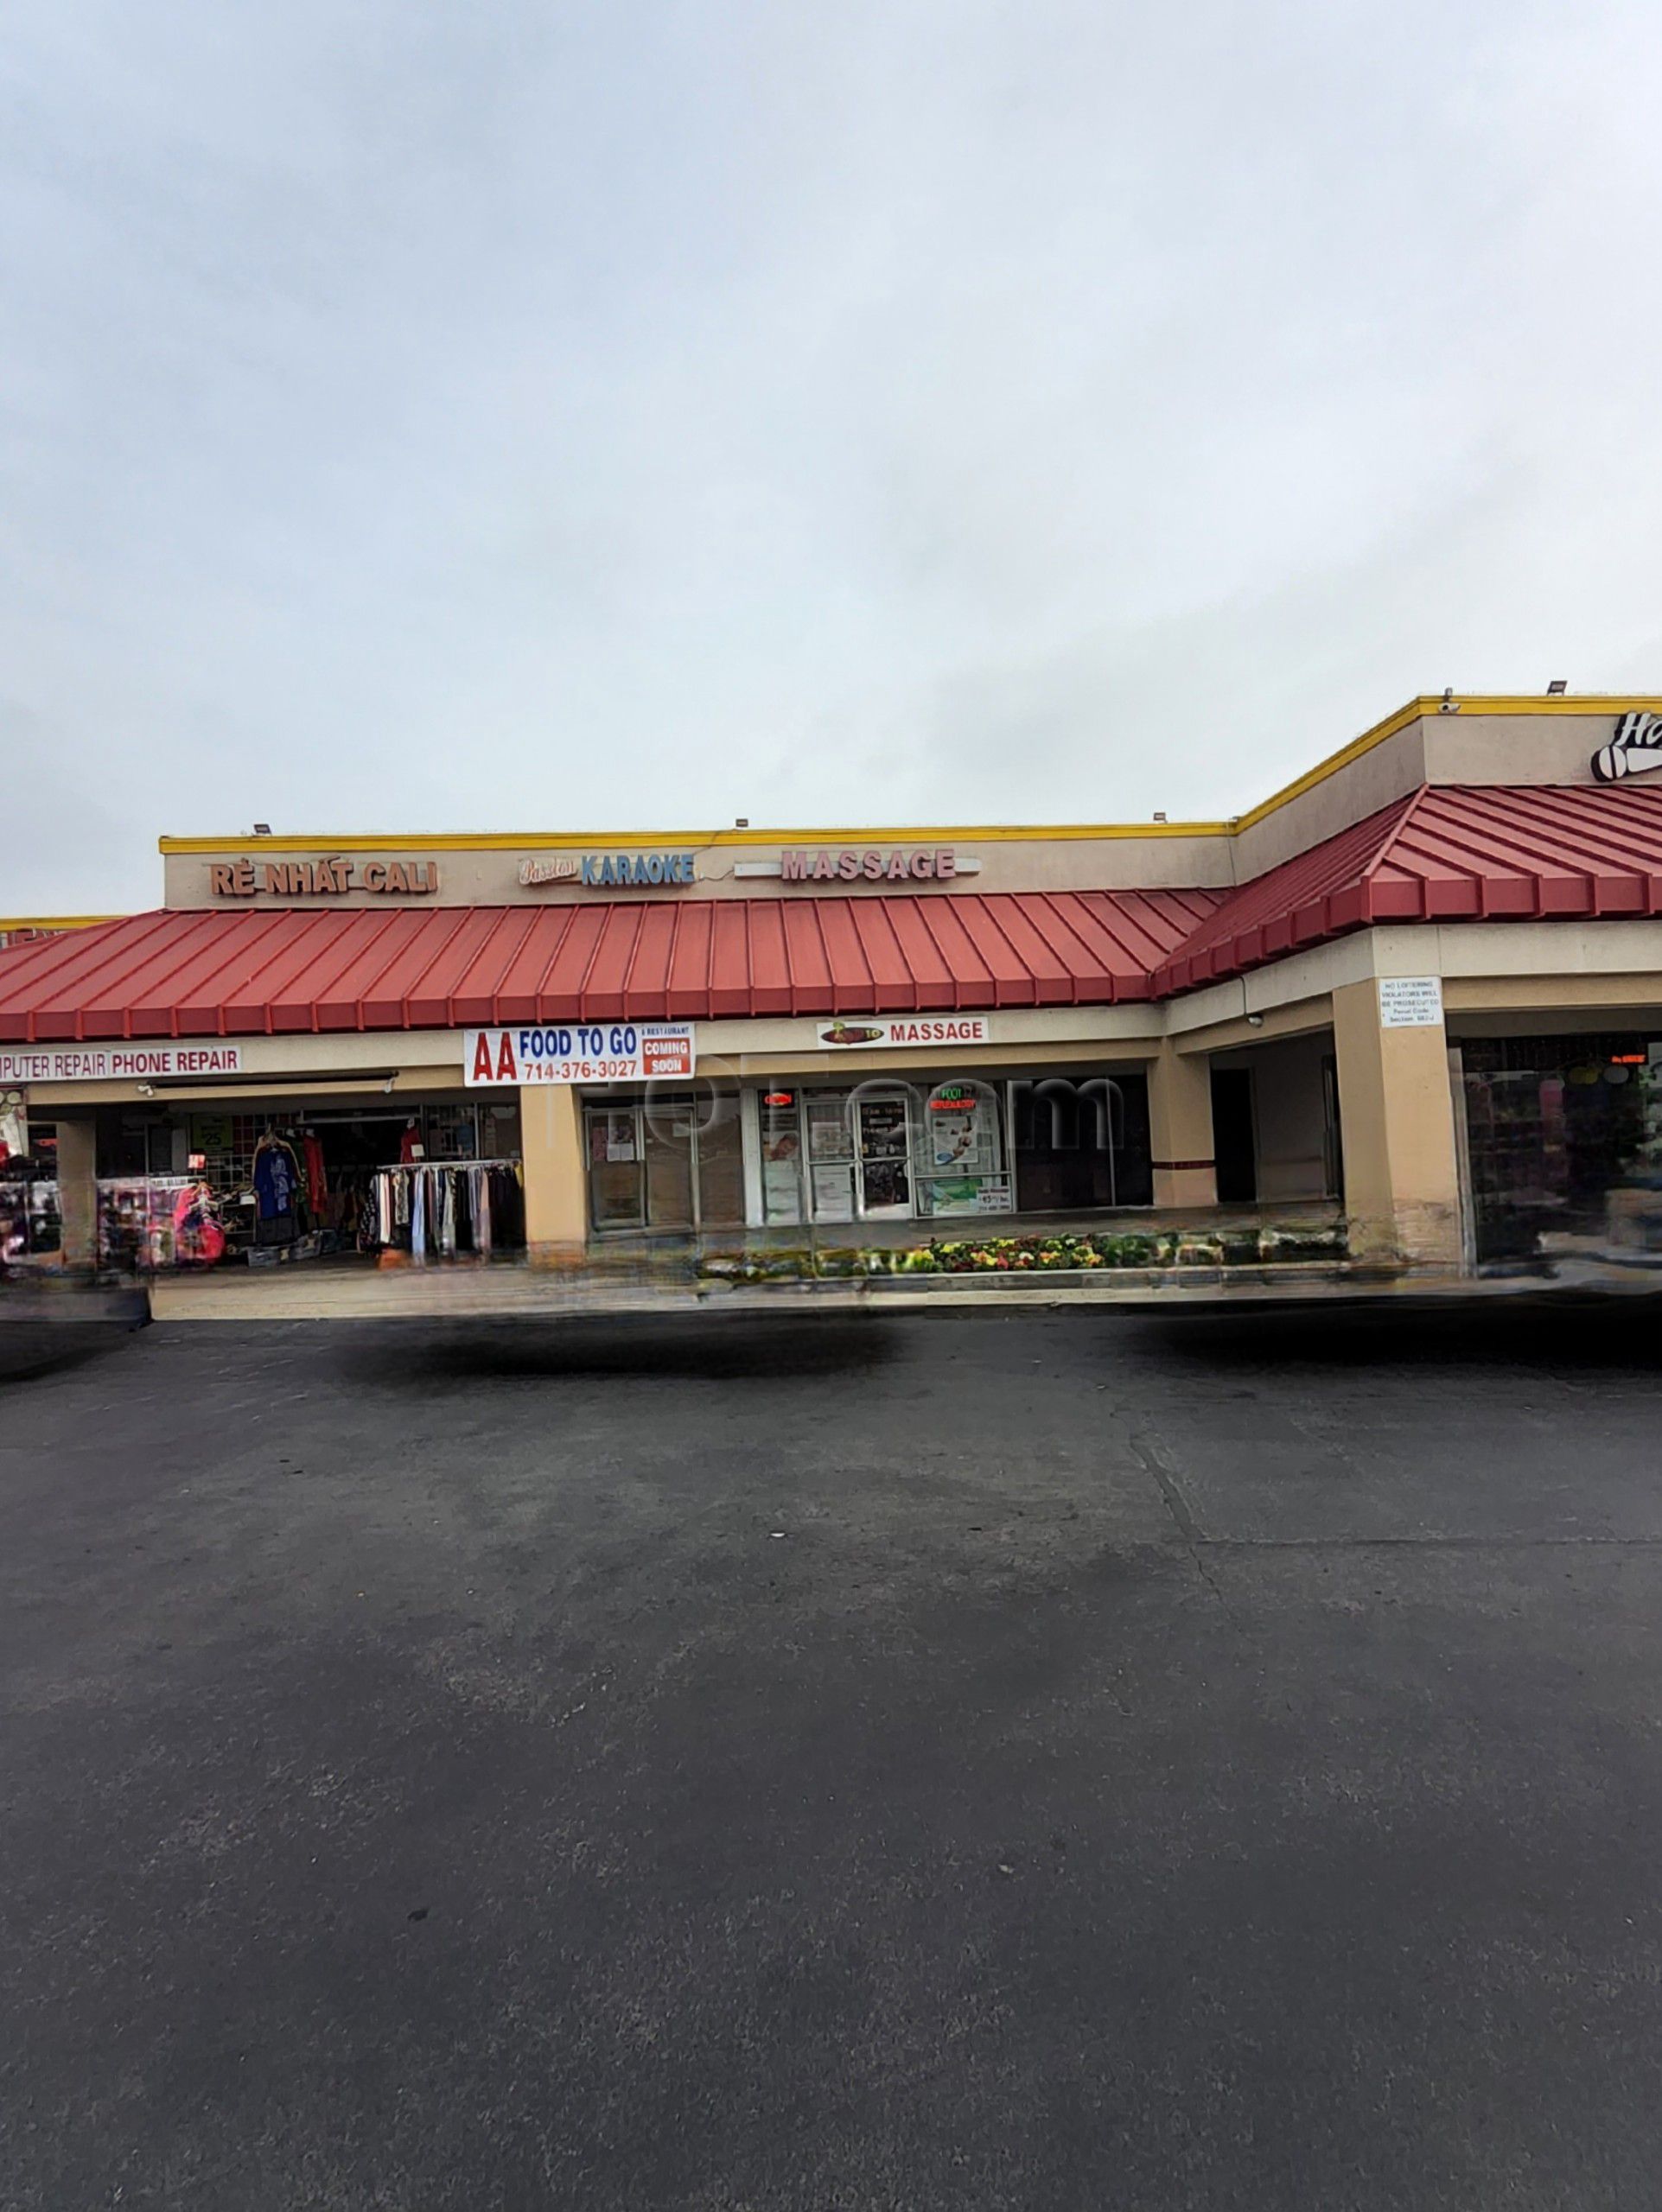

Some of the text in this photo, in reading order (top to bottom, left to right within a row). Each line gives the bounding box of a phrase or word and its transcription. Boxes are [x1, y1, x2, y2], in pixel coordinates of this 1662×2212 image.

[363, 861, 439, 892] CALI
[582, 854, 695, 886] KARAOKE
[781, 849, 957, 880] MASSAGE
[520, 1026, 637, 1058] FOOD TO GO
[646, 1027, 690, 1035] RESTAURANT
[890, 1022, 983, 1041] MASSAGE
[645, 1041, 688, 1055] COMING
[54, 1053, 105, 1077] REPAIR
[111, 1050, 238, 1074] PHONE REPAIR
[652, 1058, 683, 1072] SOON
